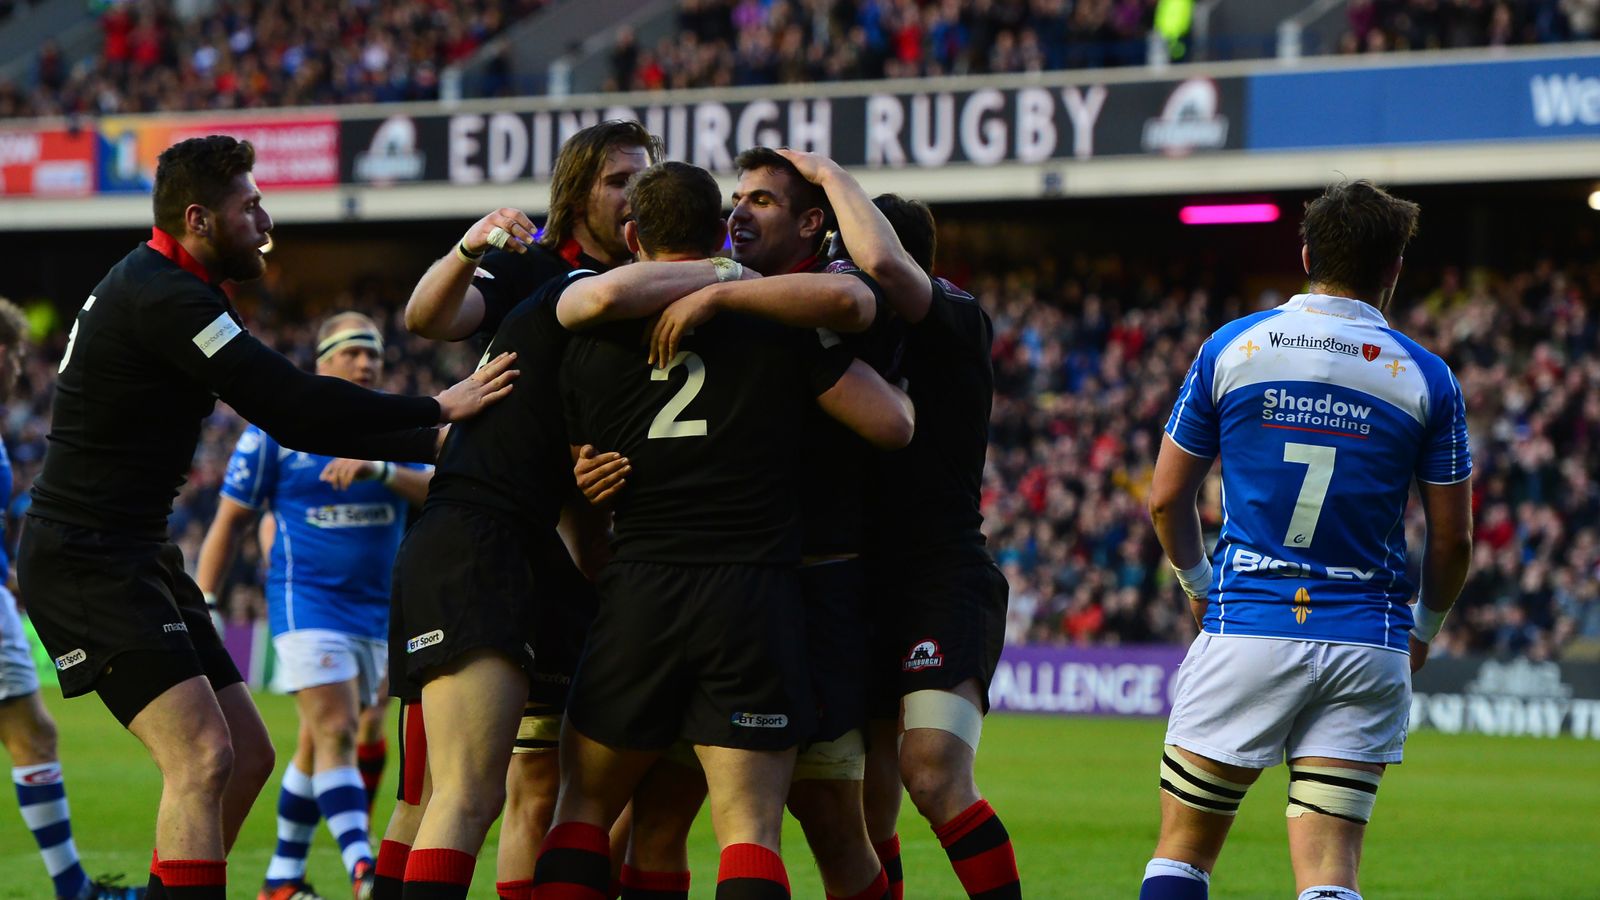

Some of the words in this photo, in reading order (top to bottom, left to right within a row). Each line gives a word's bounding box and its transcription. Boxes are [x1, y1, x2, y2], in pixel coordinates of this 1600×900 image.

[448, 96, 833, 185] EDIURGH
[864, 83, 1108, 168] RUGBY
[1268, 331, 1360, 357] Worthington's
[647, 350, 708, 439] 2
[1263, 388, 1372, 420] Shadow
[1262, 409, 1371, 435] Scaffolding
[1283, 441, 1337, 548] 7
[410, 641, 420, 650] BT
[420, 632, 440, 647] Sport
[58, 658, 68, 668] BT
[66, 651, 83, 665] Sport
[739, 716, 753, 724] BT
[755, 715, 784, 726] Sport
